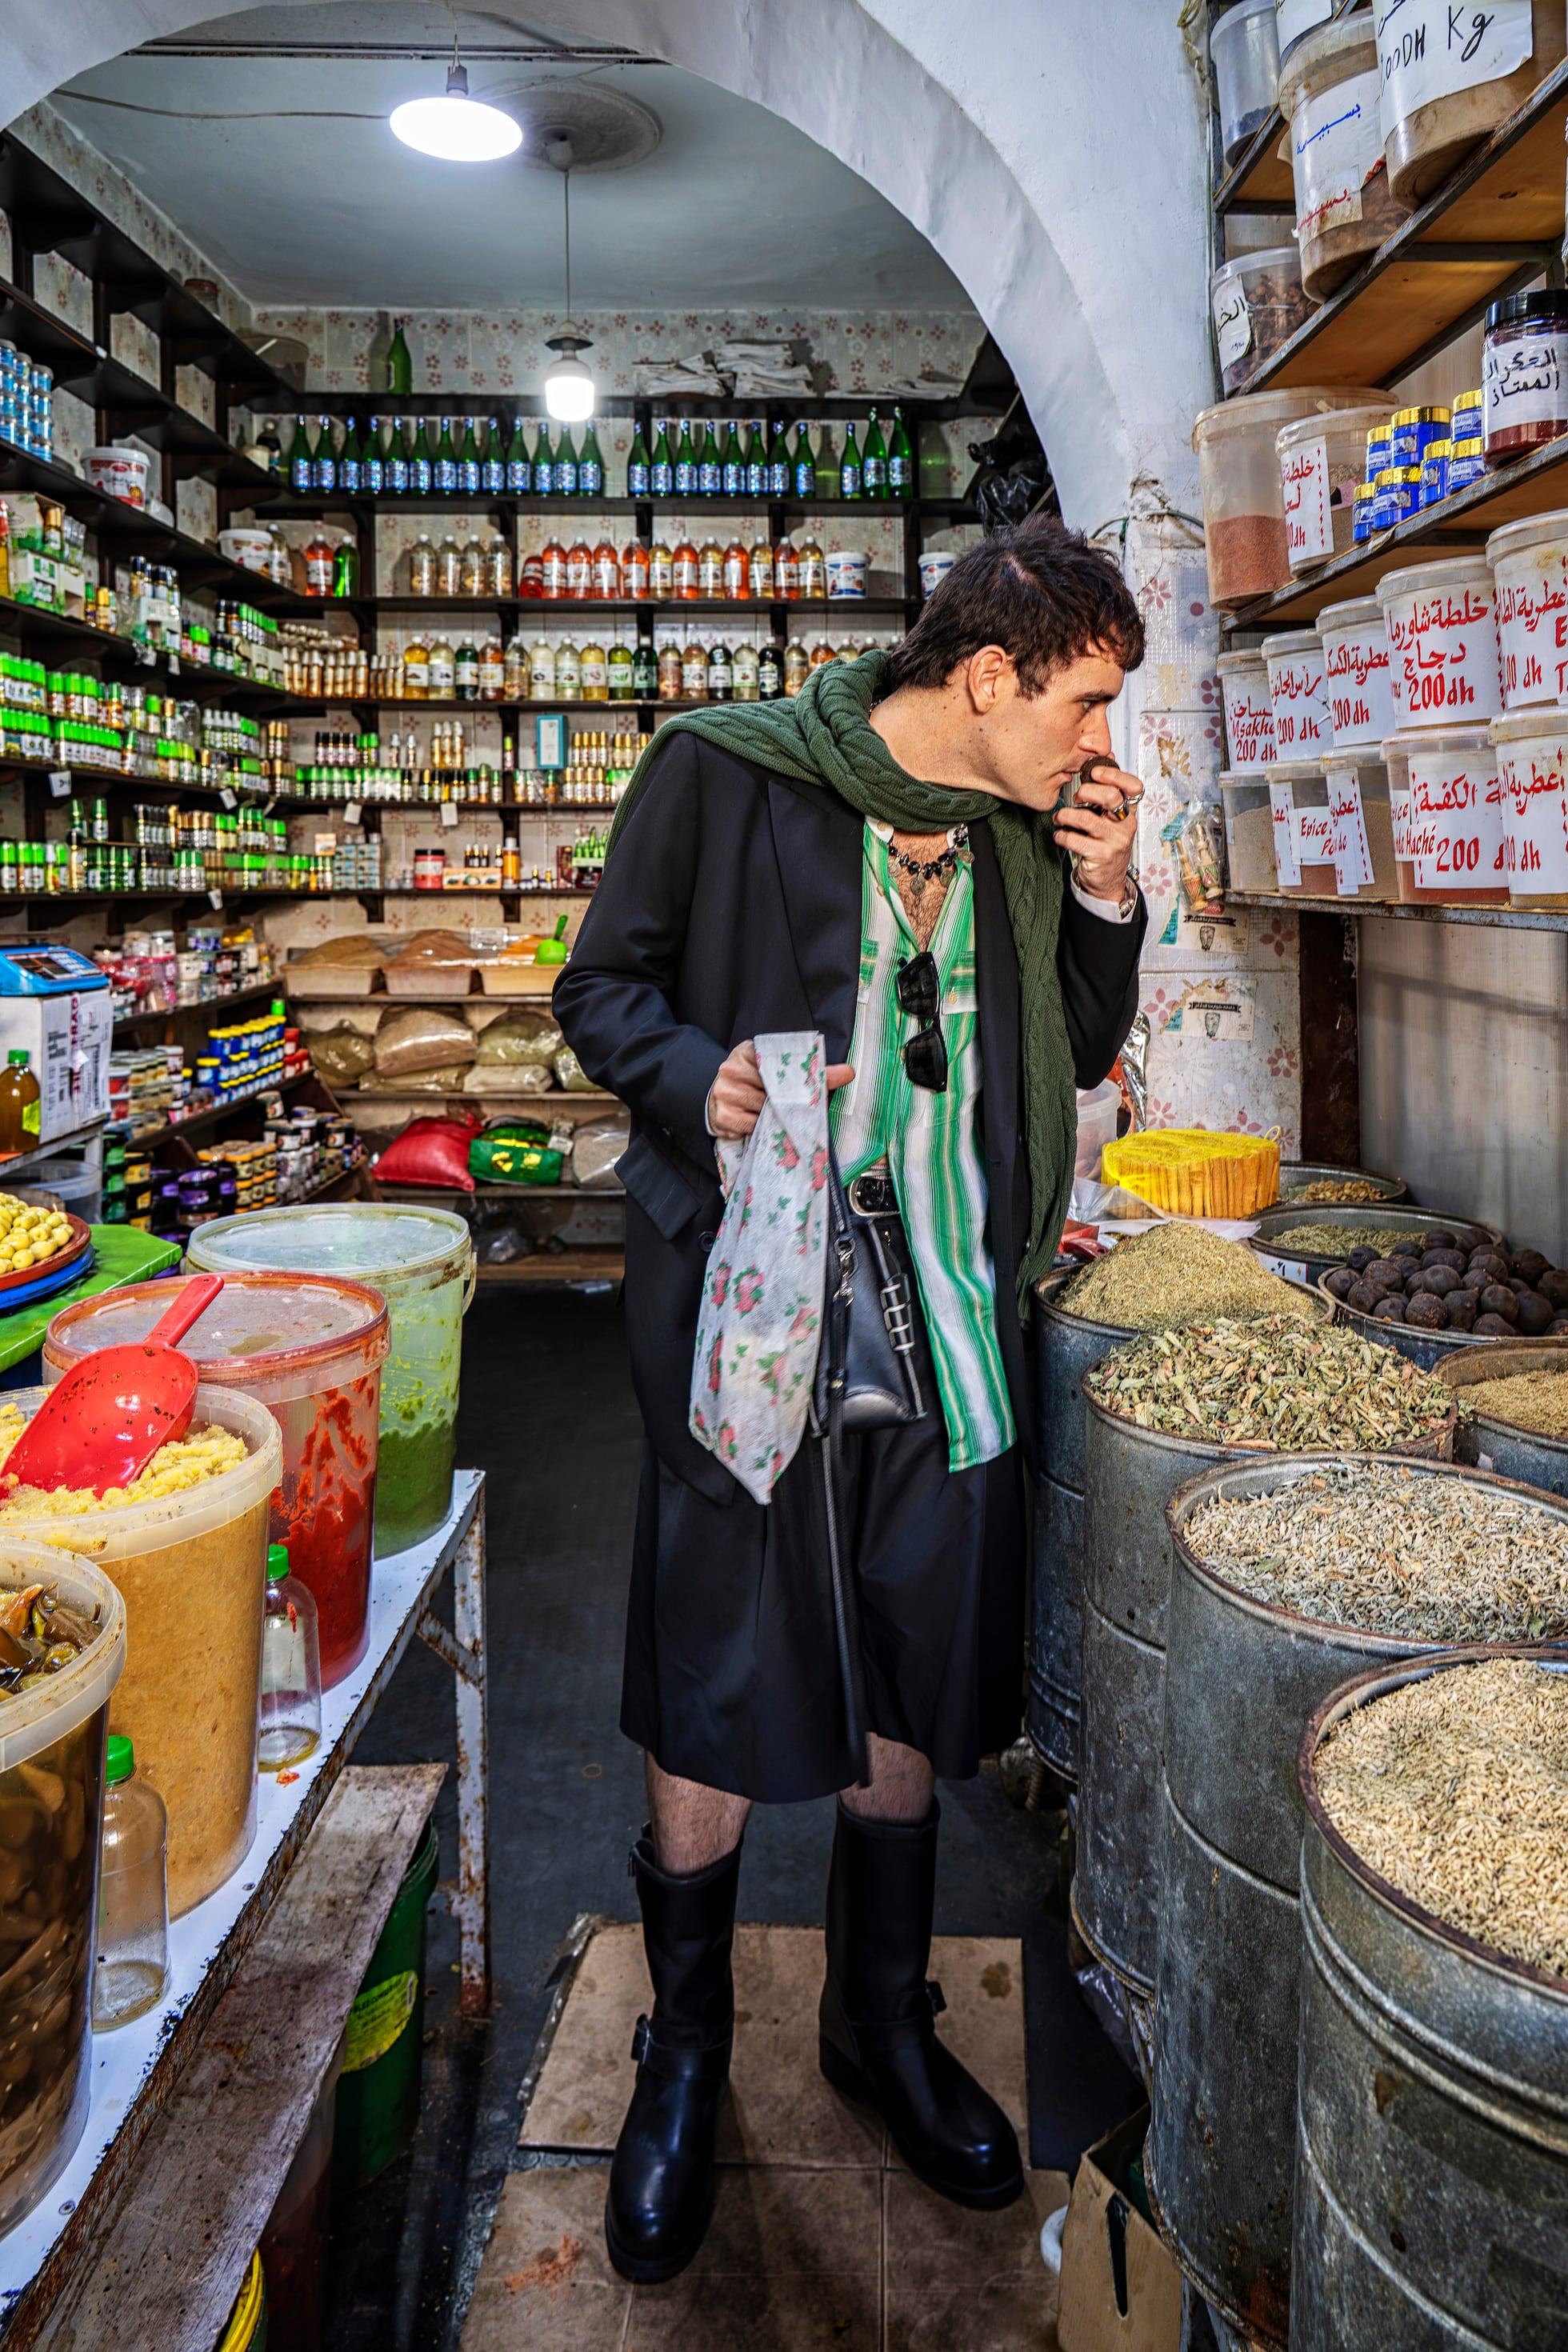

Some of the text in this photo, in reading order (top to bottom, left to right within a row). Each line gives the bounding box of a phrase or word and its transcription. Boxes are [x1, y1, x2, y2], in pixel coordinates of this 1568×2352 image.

[1448, 6, 1495, 62] Kg
[1492, 370, 1560, 407] الممتاز
[1389, 589, 1490, 651] خلطة شاورما
[1354, 645, 1390, 686] عطرية
[1404, 639, 1467, 682] دجاج
[1522, 654, 1542, 690] dh
[1232, 717, 1274, 739] Msakhe
[1277, 716, 1321, 746] 200 dh
[1331, 697, 1370, 731] 200 dh
[1236, 738, 1278, 762] 200 dh
[1509, 761, 1559, 816] عطرية
[1300, 815, 1329, 841] Epice
[1406, 823, 1438, 857] Haché
[1436, 836, 1480, 872] 200
[1521, 839, 1542, 872] dh
